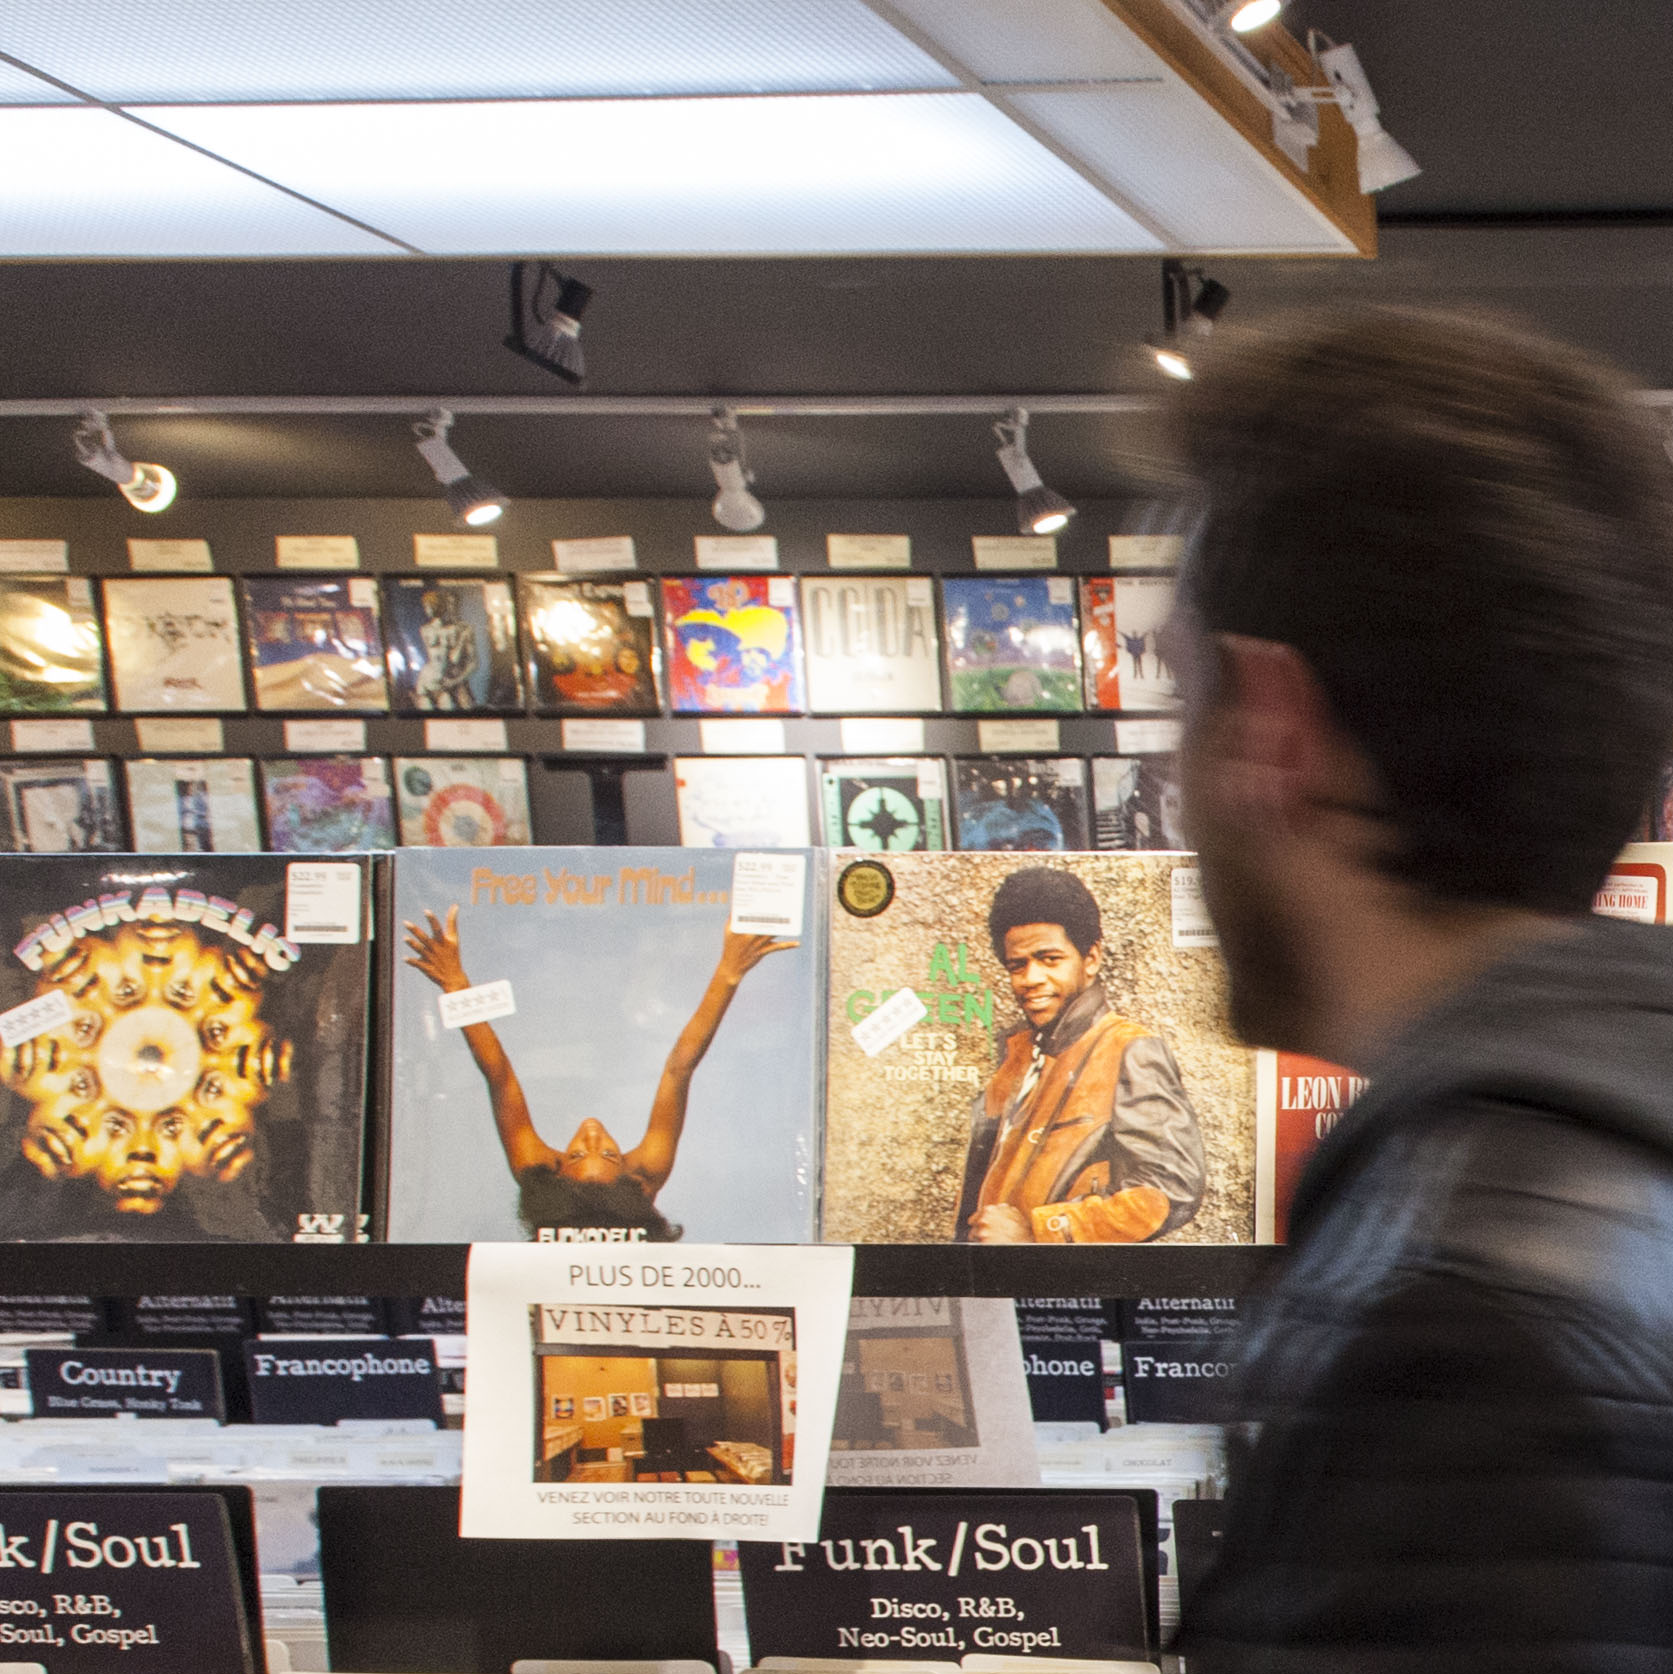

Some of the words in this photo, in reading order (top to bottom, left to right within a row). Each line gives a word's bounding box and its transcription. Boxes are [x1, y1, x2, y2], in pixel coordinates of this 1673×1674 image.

[470, 867, 539, 905] Free
[543, 868, 612, 905] Your
[929, 942, 980, 985] AL
[914, 1051, 956, 1067] STAY
[884, 1065, 980, 1083] TOGETHER
[1281, 1077, 1341, 1111] LEON
[569, 1265, 632, 1287] PLUS
[641, 1266, 675, 1288] DE
[681, 1267, 762, 1290] 2000...
[545, 1308, 706, 1336] VINYLES
[715, 1312, 735, 1337] À
[741, 1319, 768, 1340] 50
[60, 1361, 182, 1394] Country
[254, 1354, 430, 1382] Francophone
[538, 1490, 588, 1505] VENEZ
[591, 1490, 628, 1505] VOIR
[633, 1490, 680, 1505] NOTRE
[681, 1492, 725, 1506] TOUTE
[730, 1493, 789, 1507] NOUVELLE
[573, 1511, 638, 1525] SECTION
[643, 1512, 665, 1525] AU
[669, 1512, 708, 1526] FOND
[775, 1521, 1109, 1577] Funk/Soul
[871, 1600, 950, 1622] Disco,
[958, 1599, 1025, 1622] R&B,
[838, 1628, 966, 1650] Neo-Soul,
[973, 1628, 1061, 1652] Gospel
